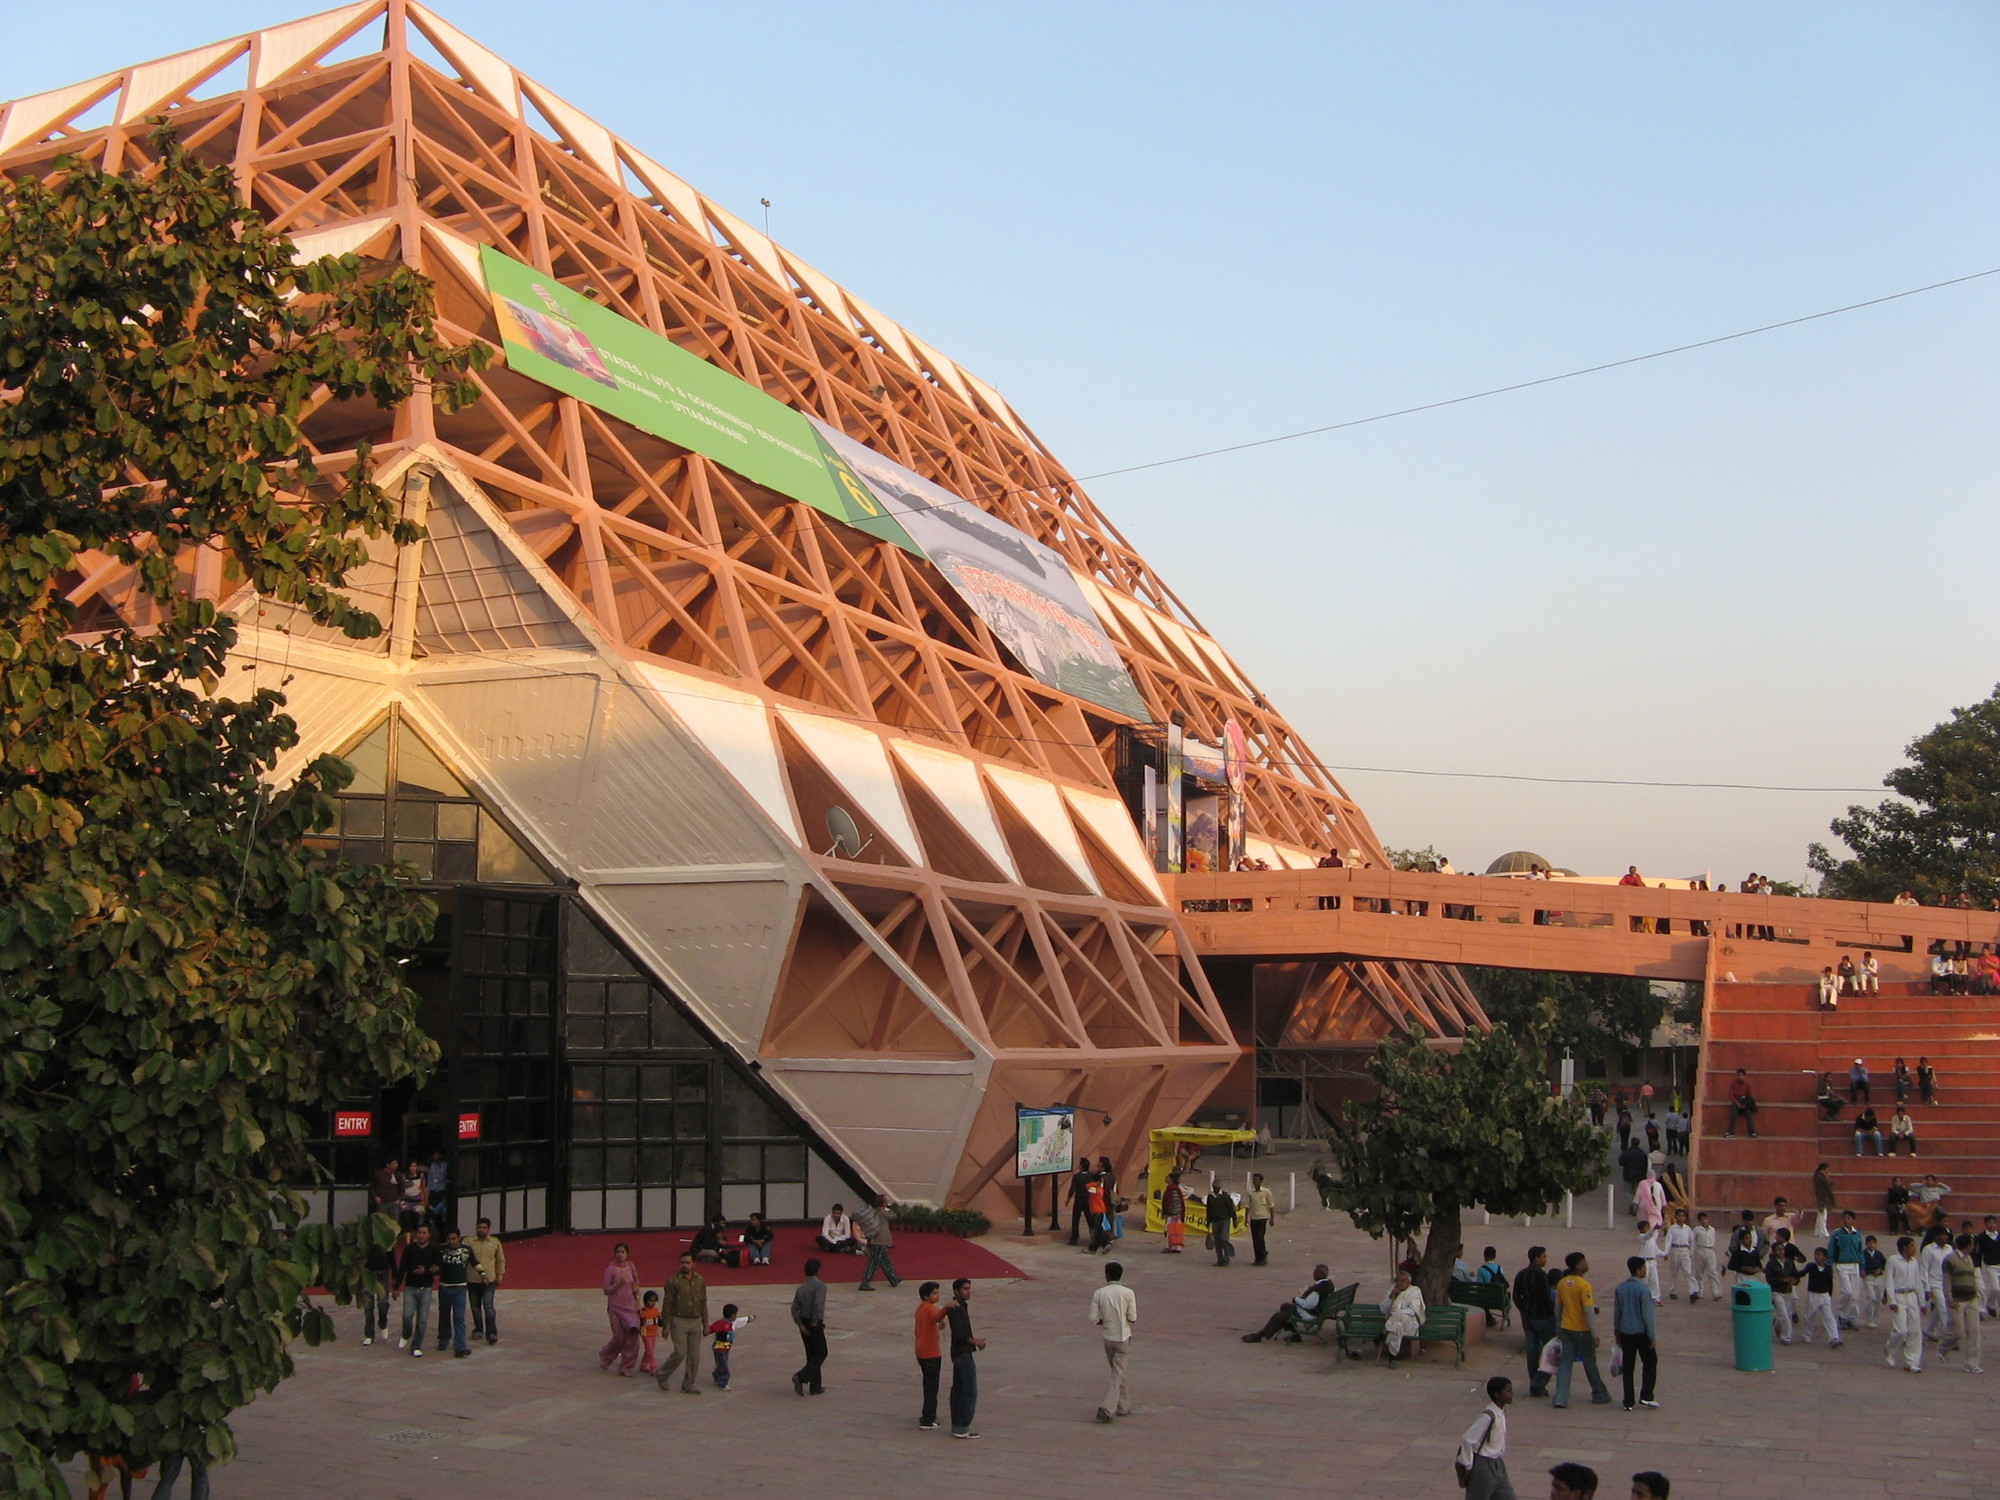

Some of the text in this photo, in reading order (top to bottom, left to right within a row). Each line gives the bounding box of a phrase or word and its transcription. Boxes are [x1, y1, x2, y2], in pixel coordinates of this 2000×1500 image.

[597, 347, 642, 376] STATES
[687, 392, 756, 434] GOVERNMENT
[670, 399, 748, 444] UTTARAKHAND
[838, 470, 878, 517] 6
[338, 1117, 369, 1130] ENTRY
[459, 1120, 478, 1133] ENTRY
